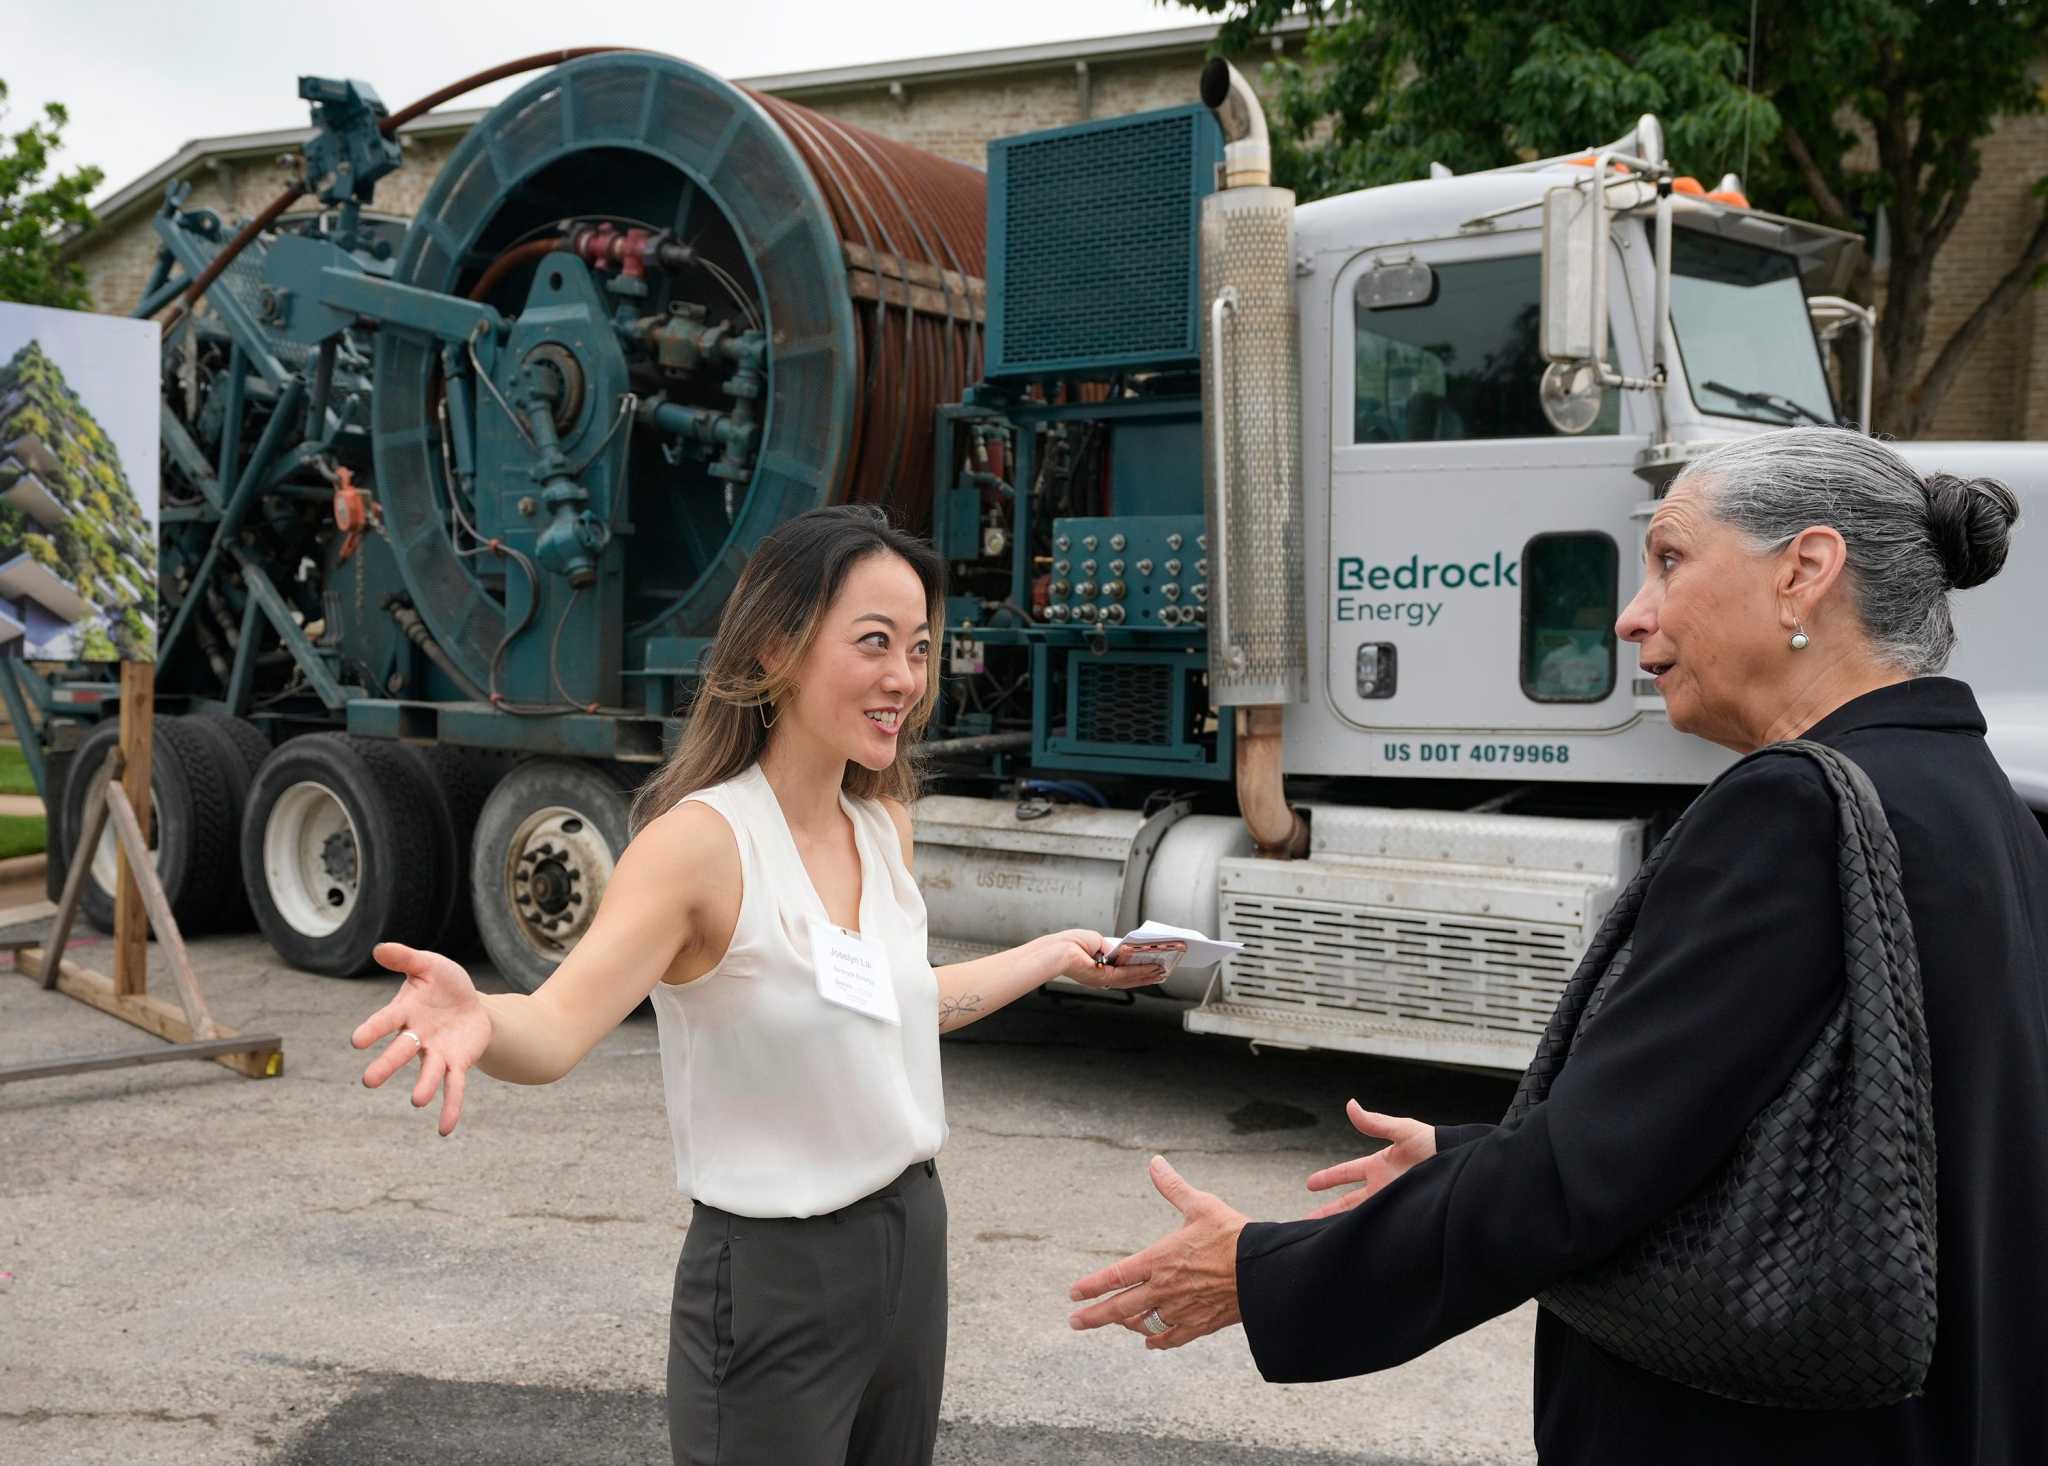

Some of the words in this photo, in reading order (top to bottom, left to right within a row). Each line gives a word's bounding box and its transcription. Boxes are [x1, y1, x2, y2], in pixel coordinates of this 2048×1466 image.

[1337, 551, 1518, 591] Bedrock
[1336, 597, 1443, 626] Energy
[1384, 743, 1411, 761] US
[1420, 743, 1461, 762] DOT
[1469, 744, 1570, 763] 4079968
